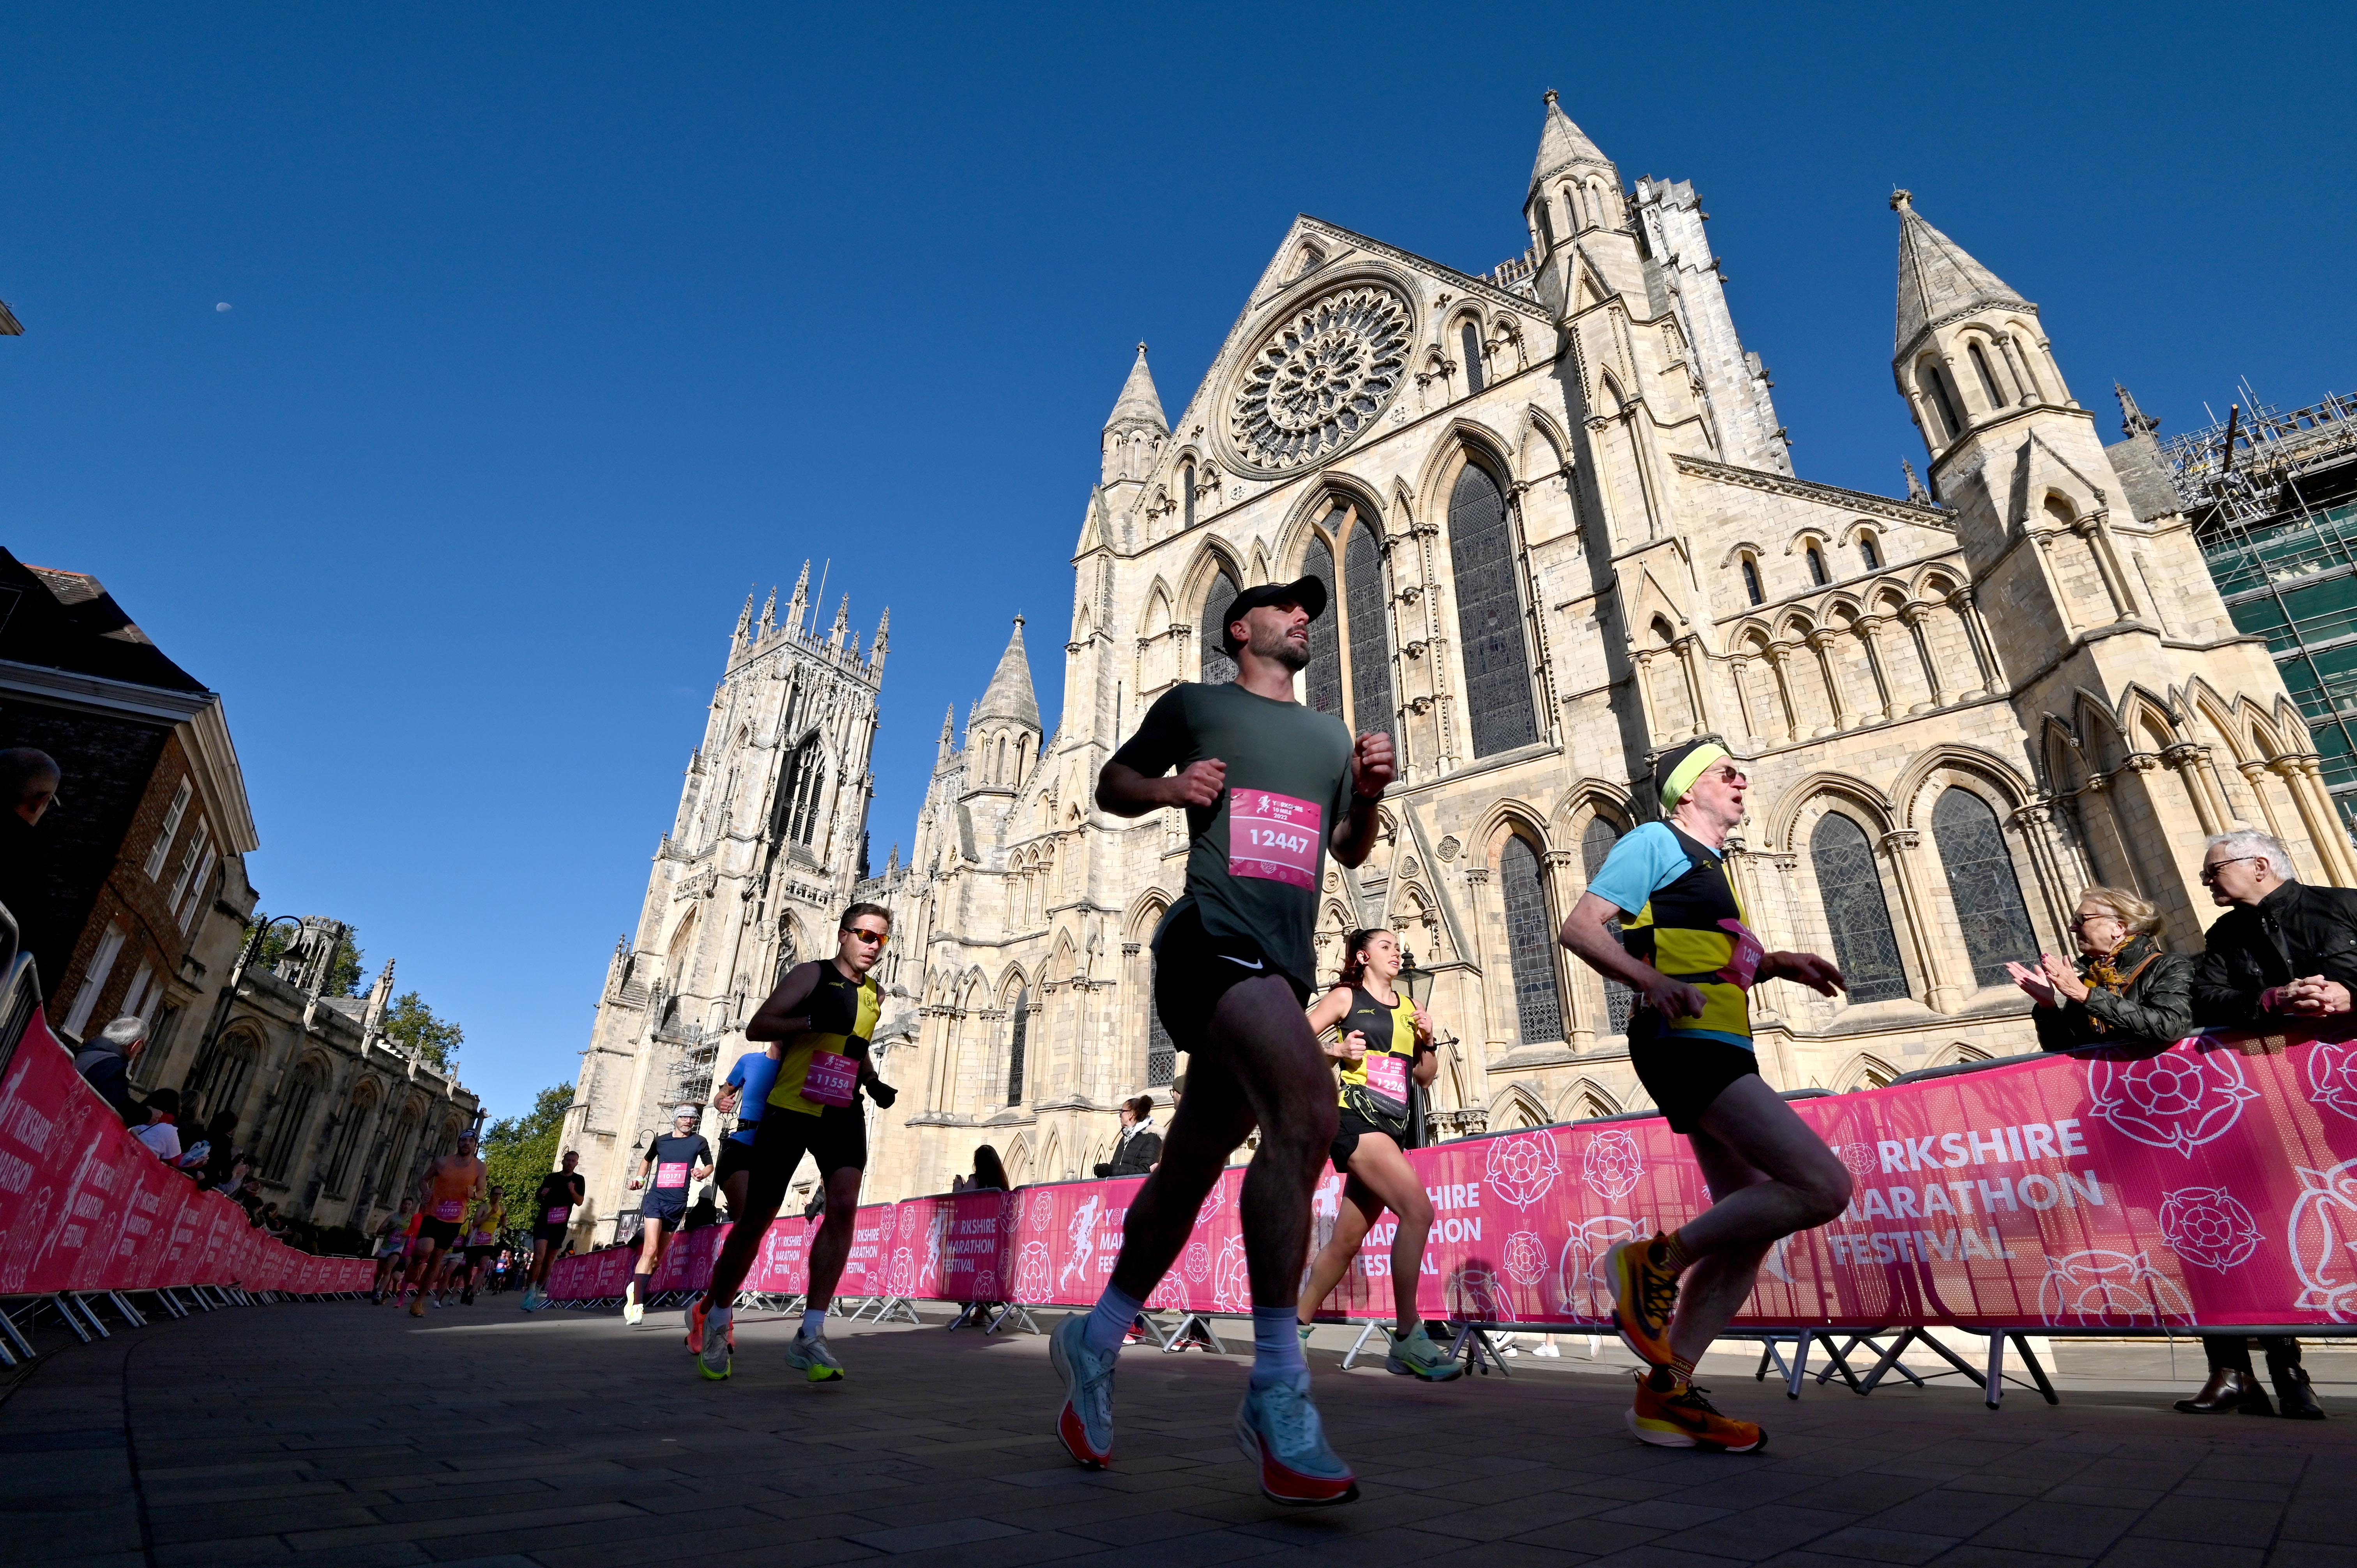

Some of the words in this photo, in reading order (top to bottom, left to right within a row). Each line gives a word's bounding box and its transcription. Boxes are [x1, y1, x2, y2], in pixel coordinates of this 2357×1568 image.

[1250, 829, 1309, 854] 12447
[817, 1074, 849, 1090] 11554
[1377, 1077, 1405, 1093] 1226
[848, 1246, 878, 1258] MARATHON
[945, 1239, 995, 1254] MARATHON
[1829, 1227, 2016, 1265] FESTIVAL
[775, 1250, 800, 1261] MARATHON
[774, 1264, 790, 1274] FESTIVAL
[846, 1262, 866, 1274] FESTIVAL
[943, 1259, 975, 1273] FESTIVAL
